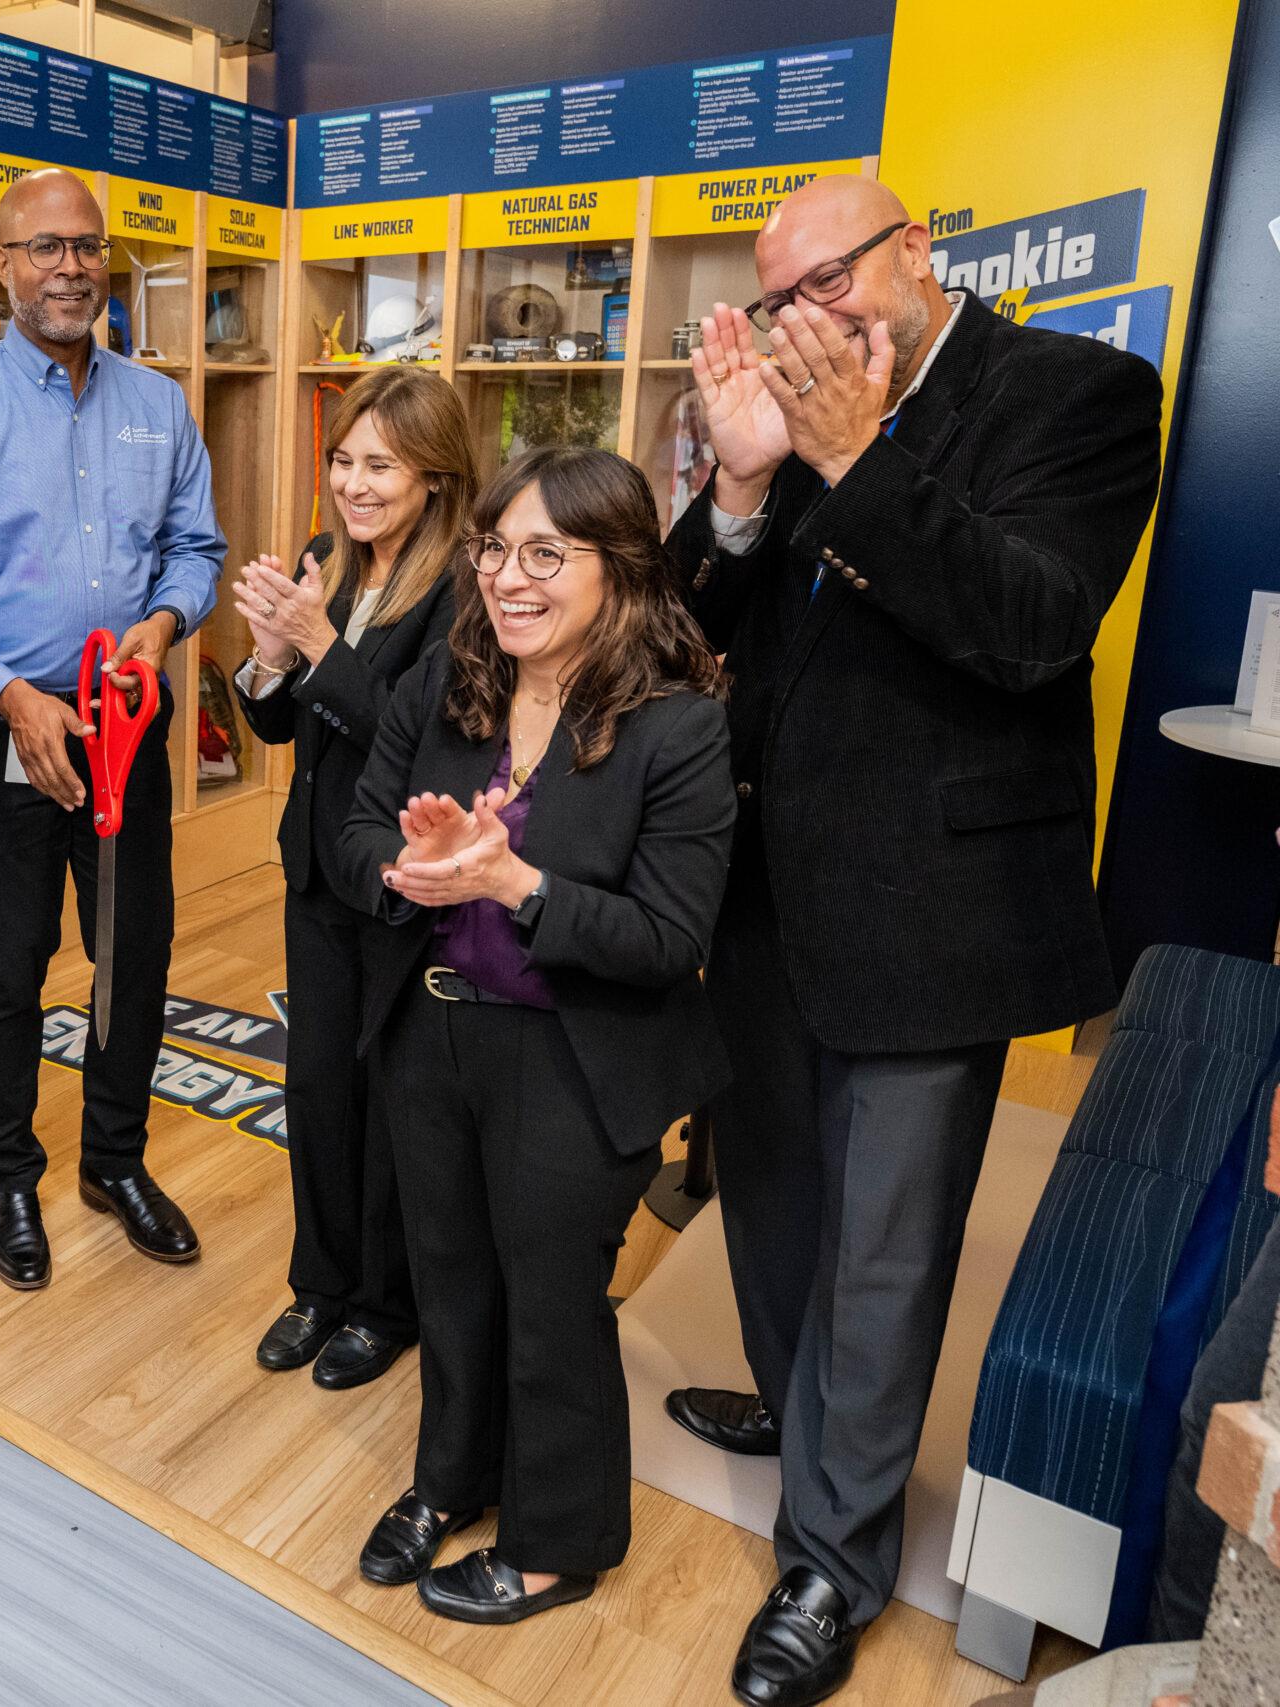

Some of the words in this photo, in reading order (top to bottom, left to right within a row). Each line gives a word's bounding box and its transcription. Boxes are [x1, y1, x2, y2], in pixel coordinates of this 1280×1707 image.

[699, 179, 757, 200] POWER
[139, 191, 163, 211] WIND
[502, 194, 564, 215] NATURAL
[568, 191, 598, 210] GAS
[712, 201, 782, 222] OPERAT
[122, 210, 177, 235] TECHNICIAN
[229, 209, 255, 228] SOLAR
[507, 215, 590, 236] TECHNICIAN
[929, 208, 973, 237] From
[219, 227, 265, 249] TECHNICIAN
[334, 224, 359, 240] LINE
[362, 219, 414, 238] WORKER
[1000, 299, 1017, 320] to
[172, 1012, 274, 1044] AN
